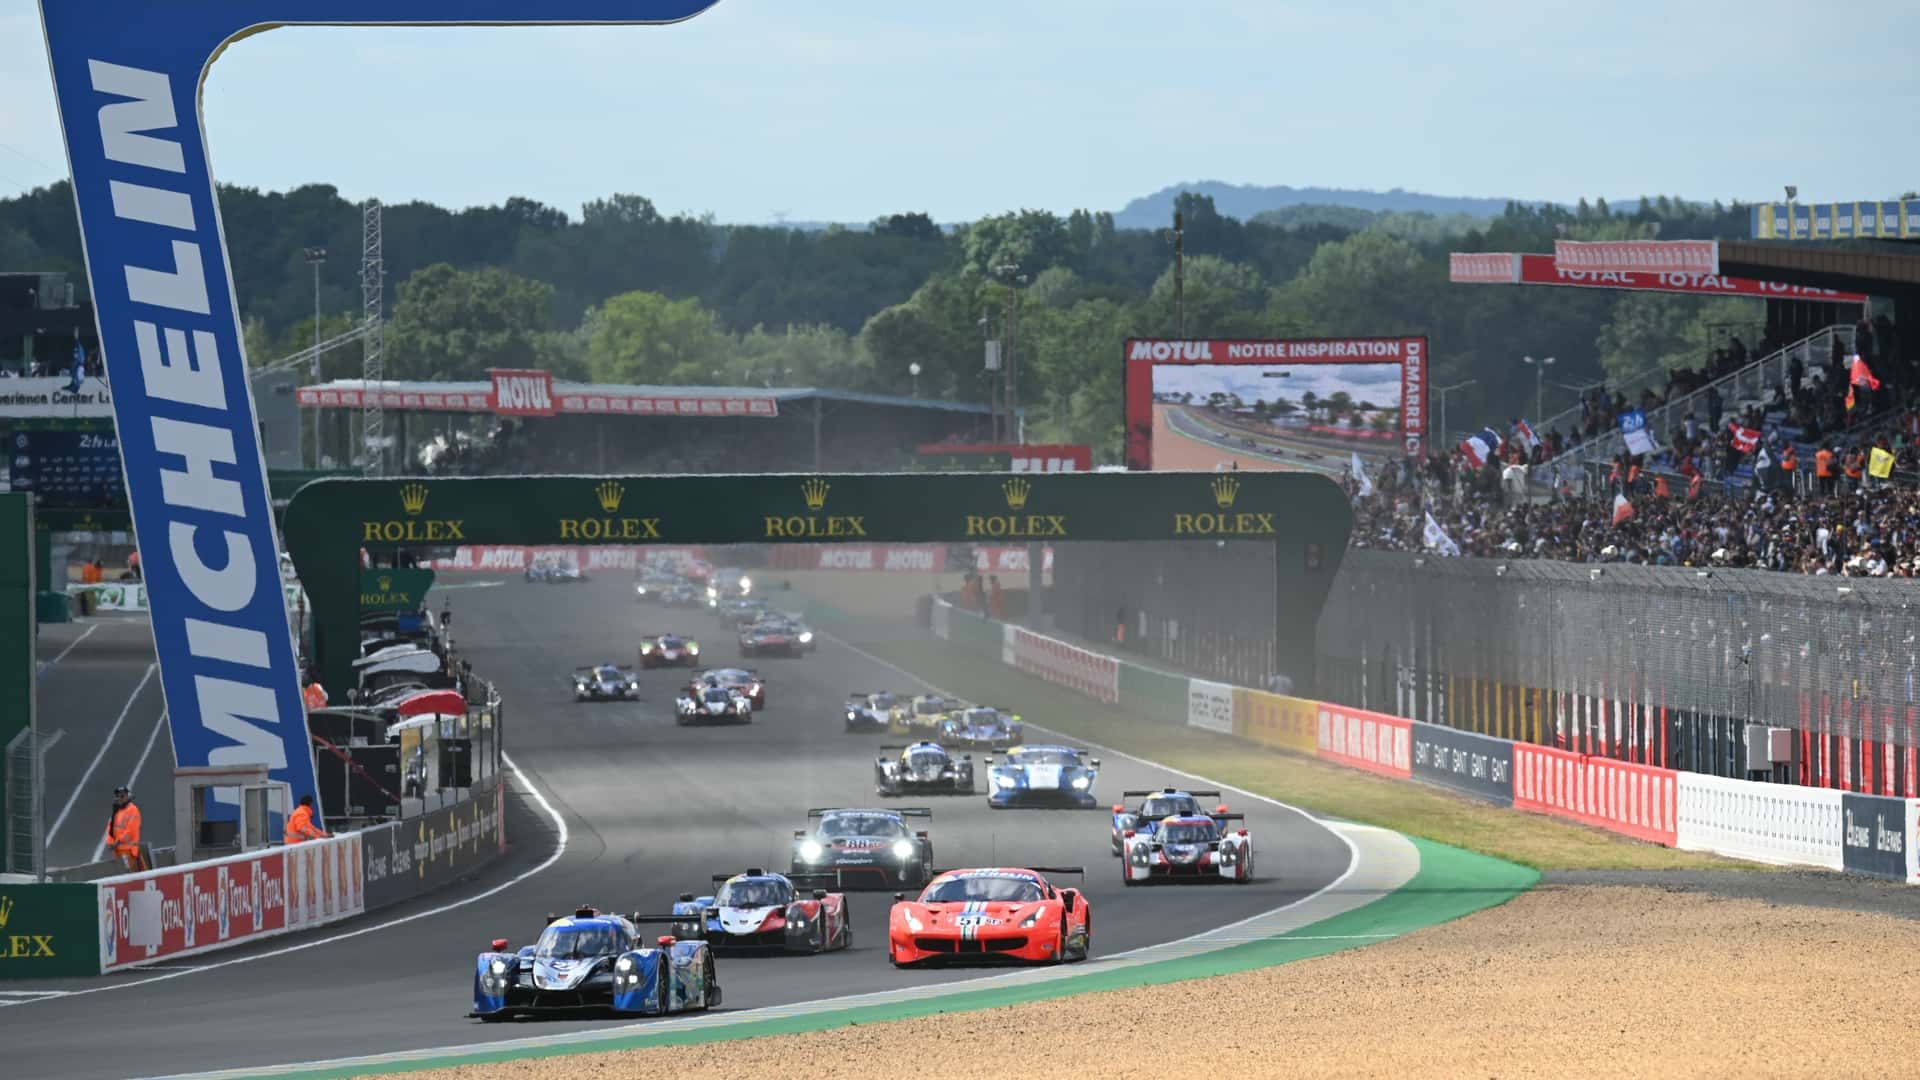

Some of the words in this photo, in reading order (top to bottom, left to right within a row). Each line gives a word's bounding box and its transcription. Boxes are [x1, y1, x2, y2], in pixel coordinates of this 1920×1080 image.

[1659, 271, 1736, 289] TOTAL
[1130, 341, 1212, 361] MOTUL
[1228, 344, 1285, 358] NOTRE
[1289, 342, 1400, 357] INSPIRATION
[496, 376, 551, 409] MOTUL
[1405, 342, 1421, 429] DEMARRE
[88, 58, 294, 818] MICHELIN
[363, 520, 465, 541] ROLEX
[559, 518, 661, 539] ROLEX
[765, 516, 867, 537] ROLEX
[966, 515, 1066, 536] ROLEX
[1174, 512, 1276, 535] ROLEX
[480, 549, 524, 568] MOTUL
[361, 592, 409, 605] ROLEX
[229, 879, 253, 918] TOTAL
[262, 872, 284, 910] TOTAL
[162, 898, 184, 933] OTAL
[194, 886, 218, 925] TOTAL
